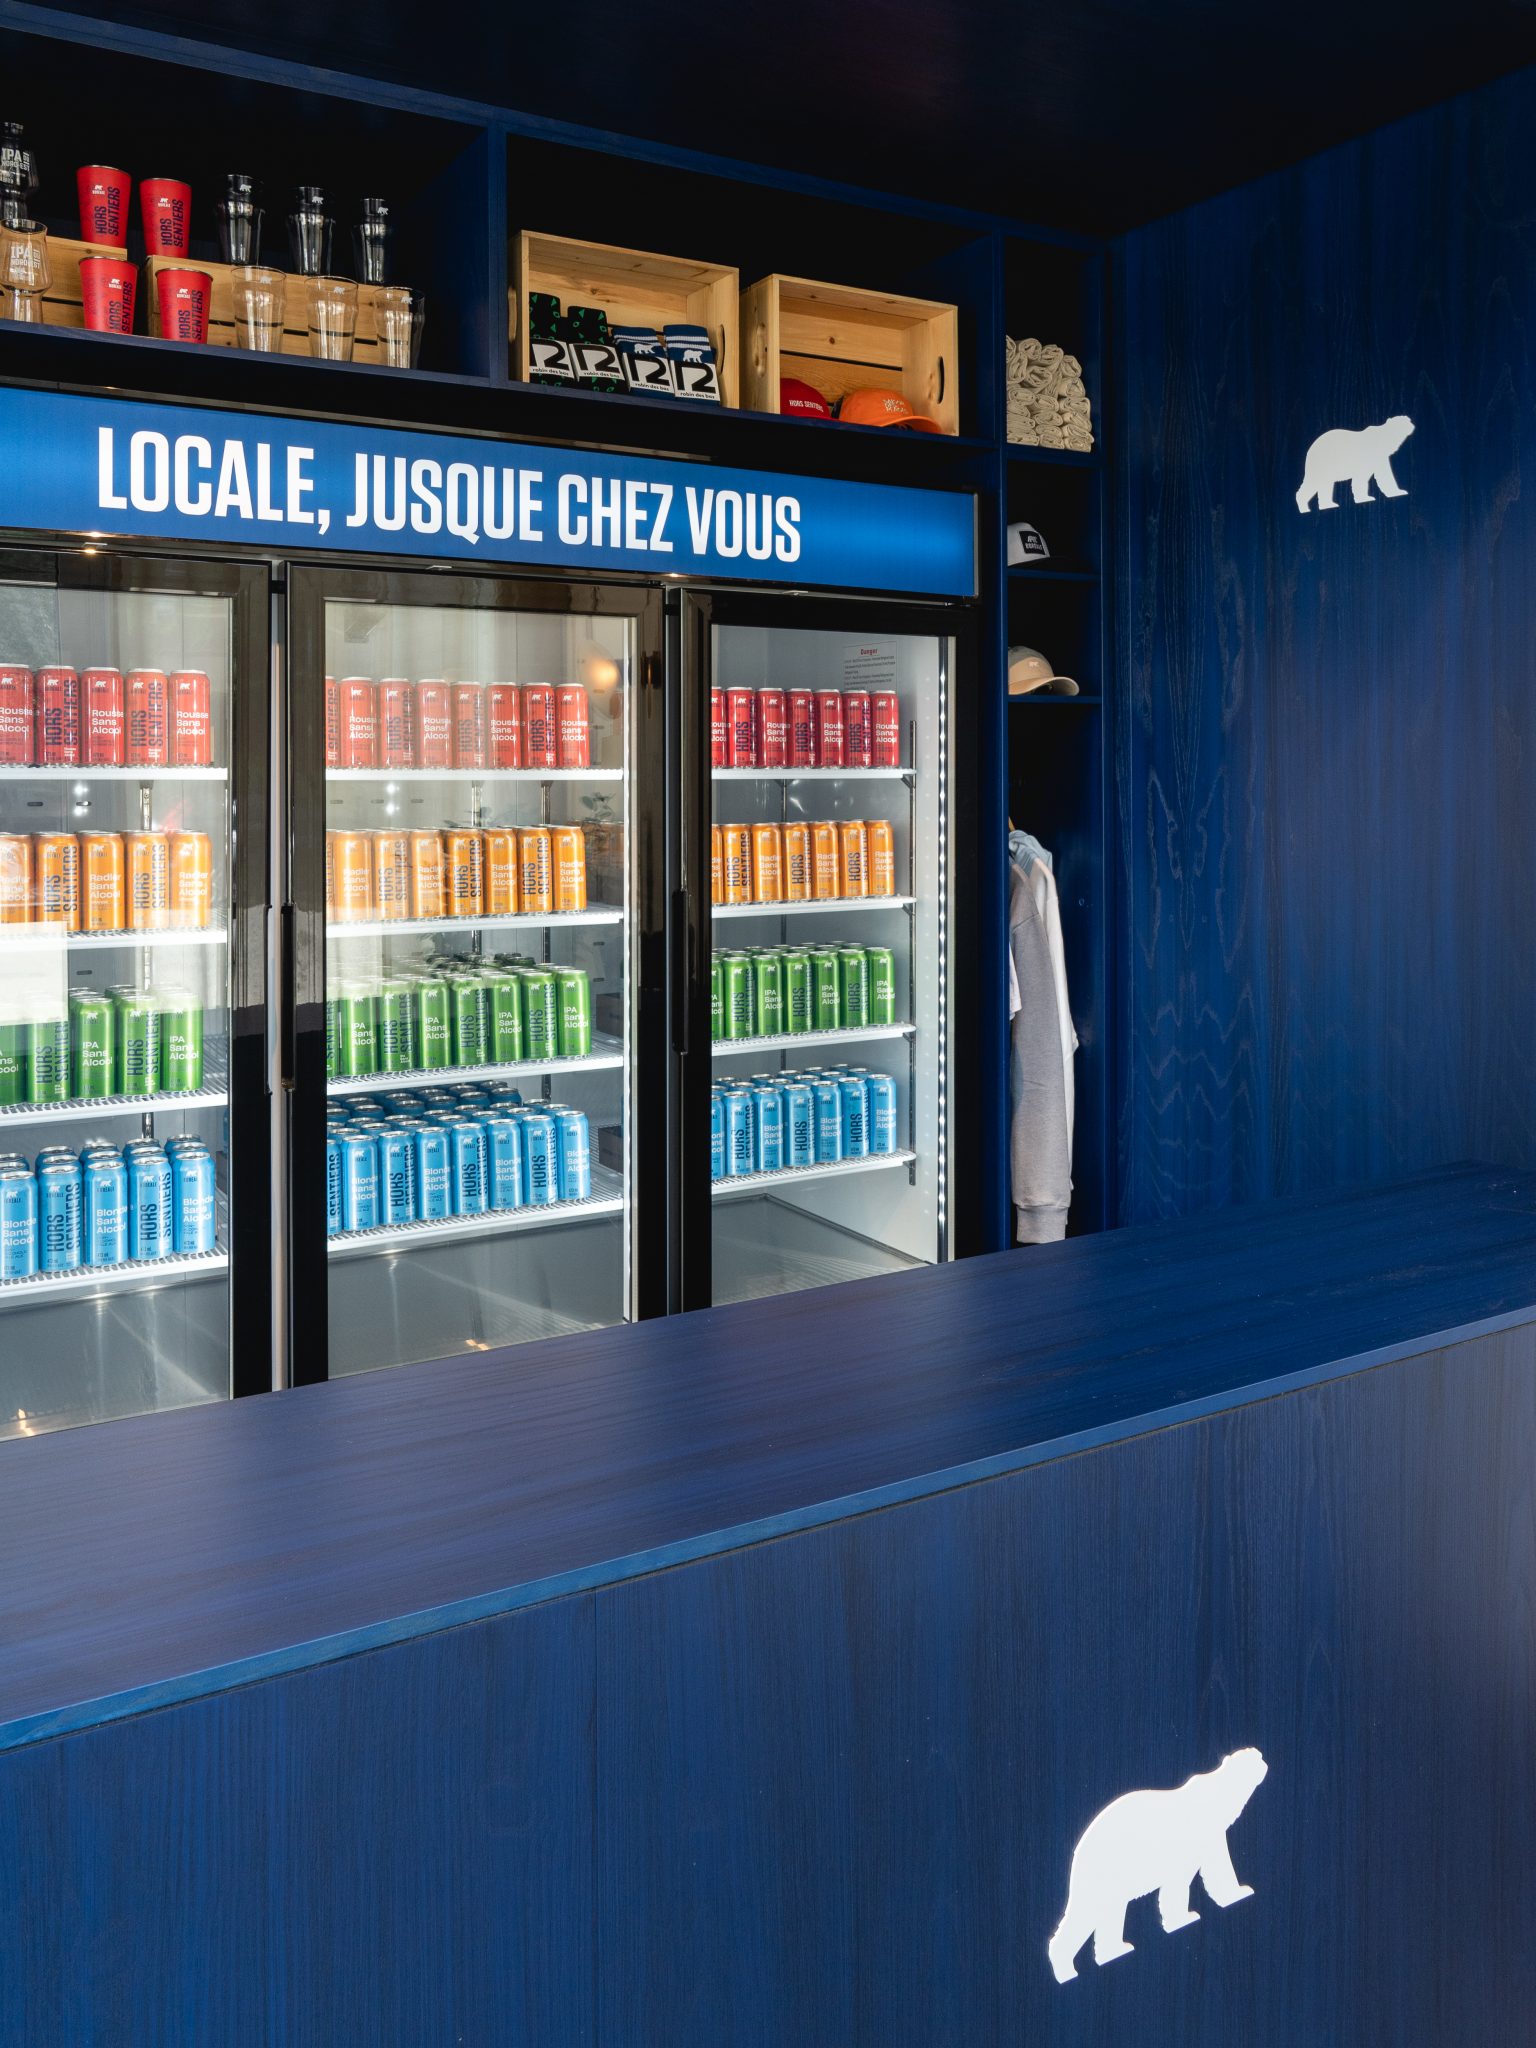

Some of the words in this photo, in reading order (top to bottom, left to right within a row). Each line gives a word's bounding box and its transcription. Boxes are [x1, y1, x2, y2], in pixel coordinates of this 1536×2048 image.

[1, 147, 22, 162] IPA
[95, 206, 107, 234] HORS
[107, 186, 120, 236] SENTIERS
[172, 199, 183, 248] SENTIERS
[160, 218, 172, 246] HORS
[11, 245, 32, 259] IPA
[109, 300, 121, 330] HORS
[122, 281, 133, 332] SENTIERS
[191, 290, 203, 340] SENTIERS
[178, 310, 191, 339] HORS
[98, 426, 331, 535] LOCALE,
[346, 452, 543, 544] JUSQUE
[558, 473, 673, 552] CHEZ
[685, 487, 801, 563] VOUS
[45, 708, 62, 745] HORS
[63, 680, 78, 746] SENTIERS
[92, 718, 117, 726] Sans
[130, 710, 147, 747] HORS
[148, 682, 163, 747] SENTIERS
[176, 719, 201, 727] Sans
[424, 724, 446, 732] Sans
[92, 727, 122, 735] Alcool
[176, 727, 206, 735] Alcool
[531, 719, 545, 752] HORS
[736, 722, 749, 752] HORS
[796, 722, 809, 752] HORS
[849, 723, 862, 752] HORS
[62, 846, 78, 912] SENTIERS
[152, 844, 166, 909] SENTIERS
[470, 839, 482, 898] SENTIERS
[522, 862, 536, 895] HORS
[537, 837, 550, 895] SENTIERS
[726, 856, 740, 887] HORS
[791, 855, 804, 884] HORS
[848, 852, 861, 882] HORS
[44, 875, 61, 913] HORS
[90, 882, 116, 890] Sans
[134, 872, 151, 909] HORS
[454, 865, 469, 899] HORS
[793, 987, 806, 1017] HORS
[848, 982, 861, 1012] HORS
[399, 994, 412, 1053] SENTIERS
[499, 1011, 513, 1019] IPA
[529, 1008, 544, 1042] HORS
[82, 1041, 99, 1049] IPA
[351, 1030, 373, 1038] Sans
[383, 1019, 398, 1054] HORS
[460, 1014, 475, 1048] HORS
[54, 1022, 69, 1081] SENTIER
[82, 1050, 108, 1058] Sans
[82, 1057, 113, 1067] Alcool
[127, 1039, 144, 1076] HORS
[169, 1044, 194, 1052] Sans
[169, 1051, 199, 1060] Alcool
[0, 1064, 18, 1073] cool
[36, 1046, 53, 1084] HORS
[794, 1121, 808, 1152] HORS
[850, 1113, 863, 1143] HORS
[731, 1129, 745, 1160] HORS
[328, 1153, 340, 1216] SENTIERS
[424, 1175, 446, 1183] Sans
[462, 1163, 477, 1198] HORS
[532, 1155, 547, 1188] HORS
[159, 1172, 172, 1238] SENTIERS
[389, 1172, 404, 1207] HORS
[66, 1182, 80, 1250] SENTIERS
[97, 1217, 122, 1226] Sans
[97, 1222, 126, 1234] Alcool
[140, 1203, 157, 1241] HORS
[2, 1228, 31, 1238] Sans
[2, 1234, 34, 1247] Alcool
[47, 1213, 65, 1252] HORS
